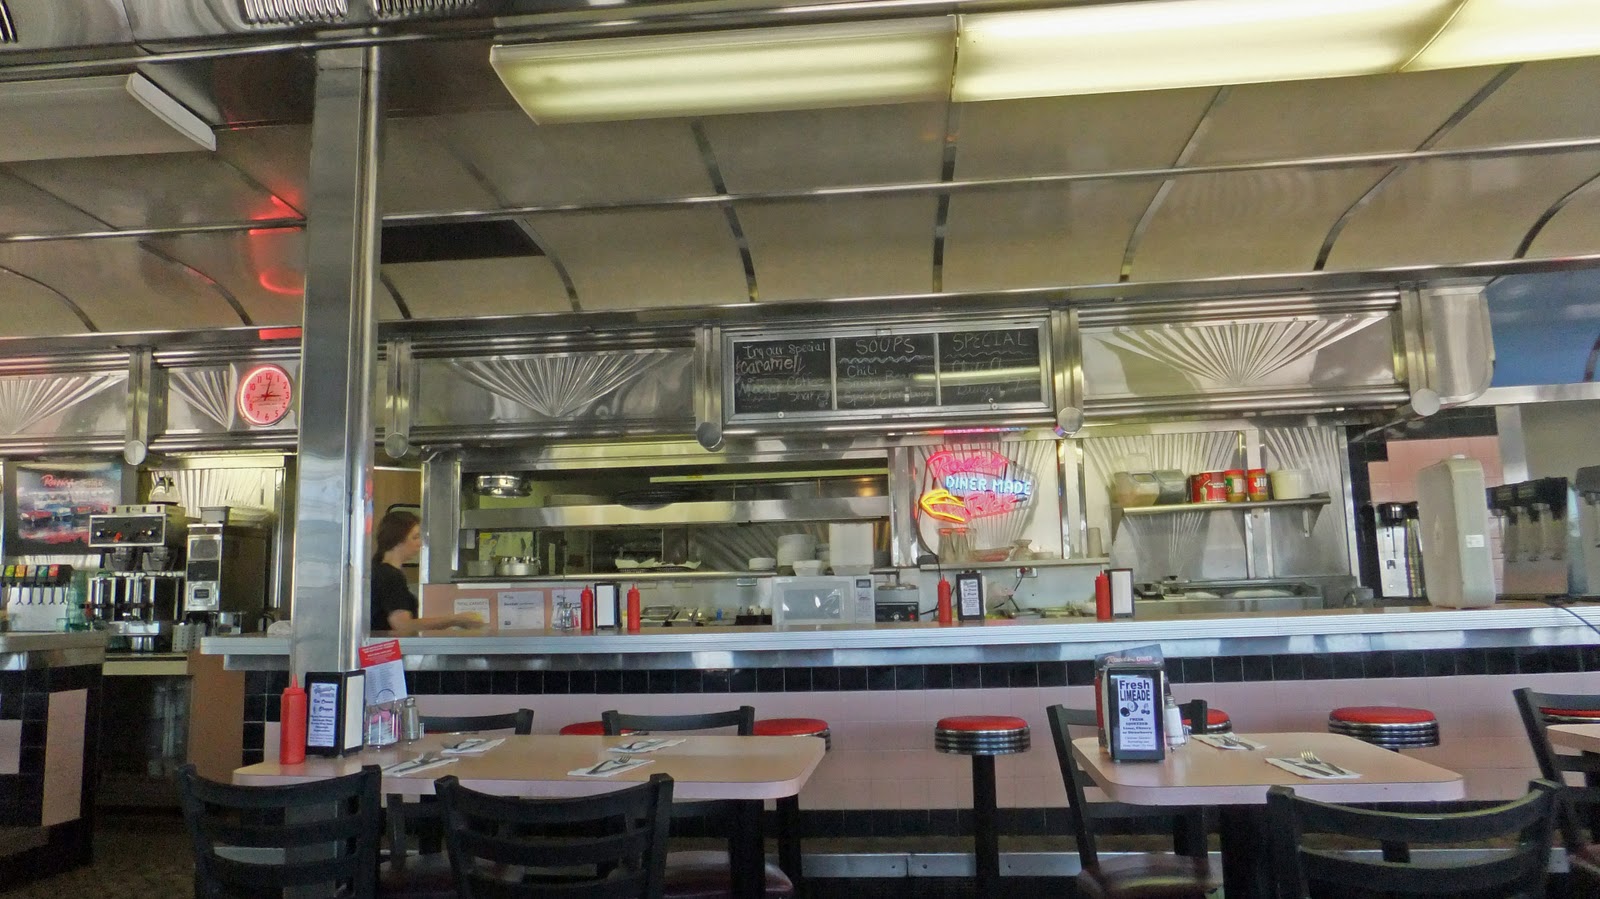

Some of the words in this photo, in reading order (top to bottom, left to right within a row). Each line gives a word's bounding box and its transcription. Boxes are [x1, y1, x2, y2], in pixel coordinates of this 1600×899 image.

[855, 336, 916, 355] SOUPS
[953, 331, 1029, 352] SPECIAL
[742, 344, 764, 359] Try
[944, 475, 988, 491] DINER
[993, 478, 1032, 494] MADE
[1119, 680, 1150, 690] Fresh
[1120, 689, 1151, 701] LIMEADE
